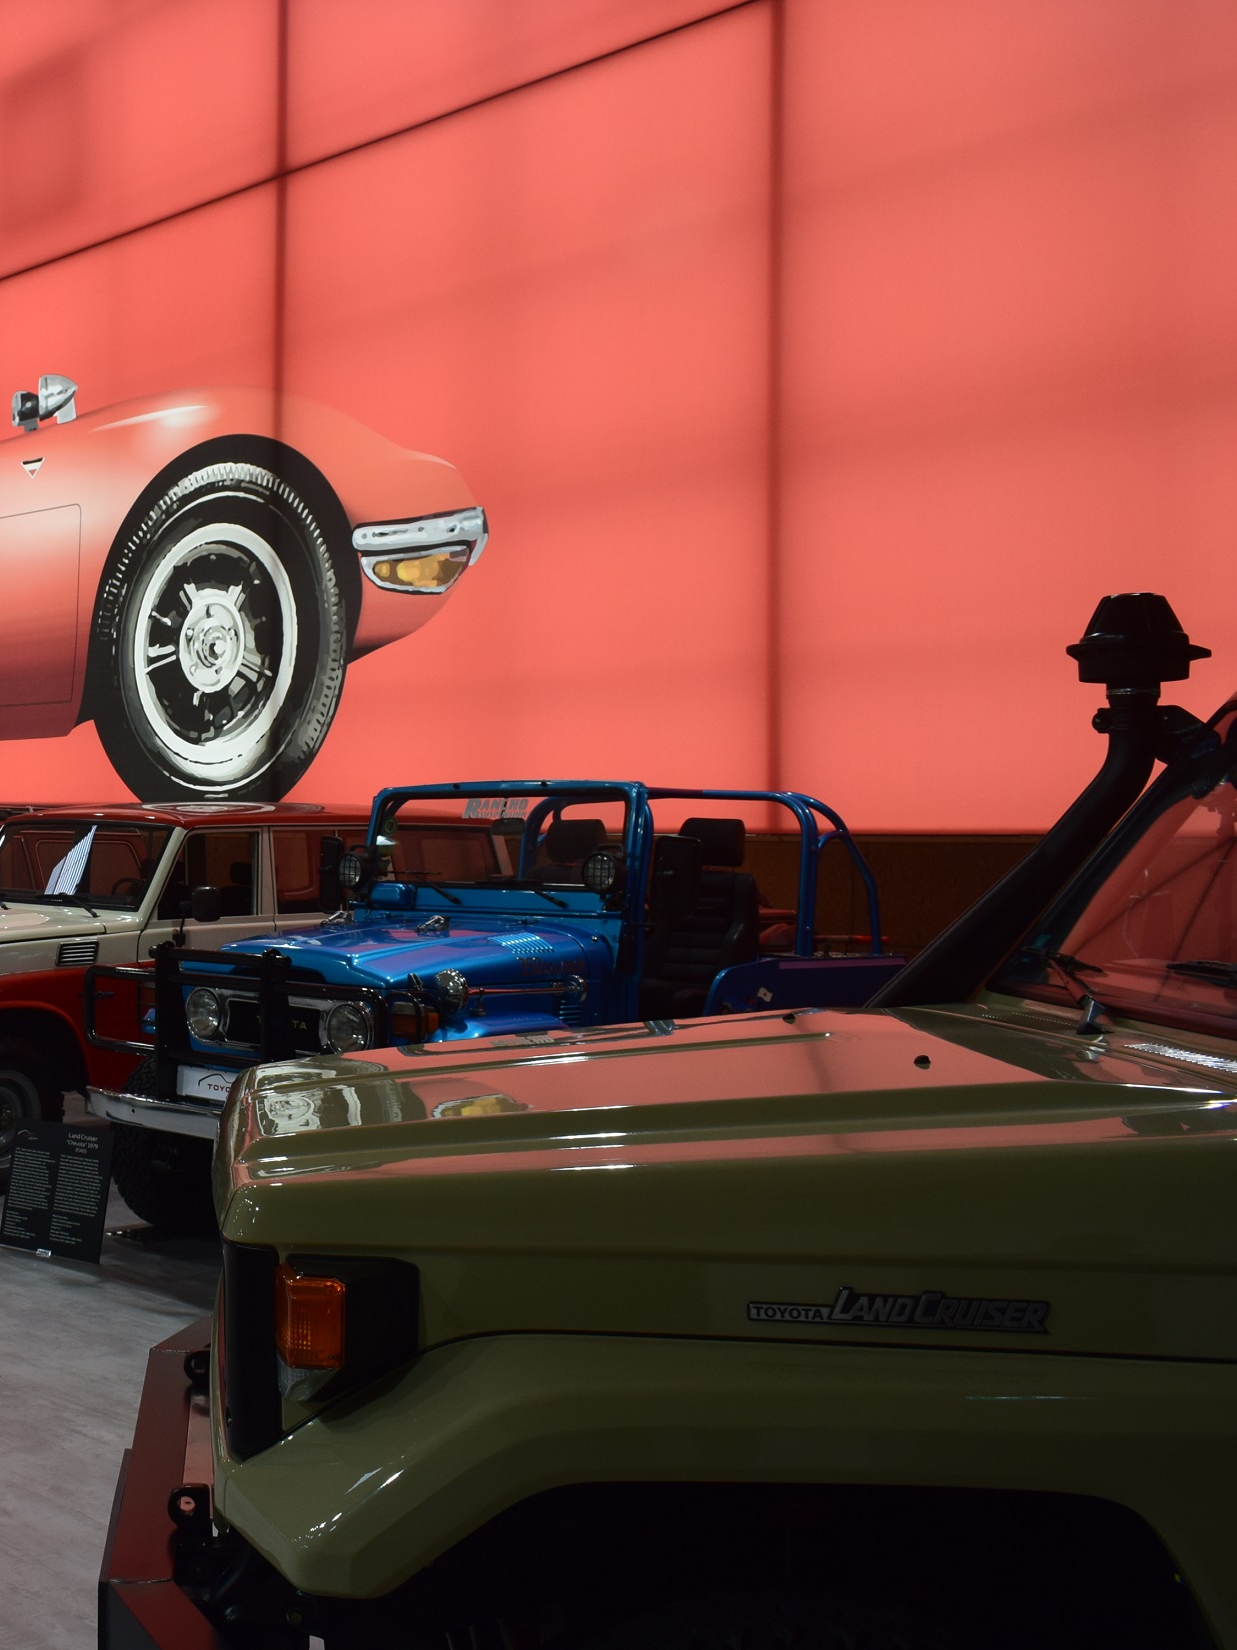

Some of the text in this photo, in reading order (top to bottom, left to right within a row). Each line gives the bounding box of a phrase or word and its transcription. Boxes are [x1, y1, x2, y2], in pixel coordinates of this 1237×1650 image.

[462, 798, 528, 819] RANCHO
[256, 1015, 308, 1030] TTA
[207, 1083, 231, 1093] TOYO
[68, 1132, 98, 1142] Land Cruiser
[752, 1286, 1046, 1333] TOYOTA LAND CRUISER
